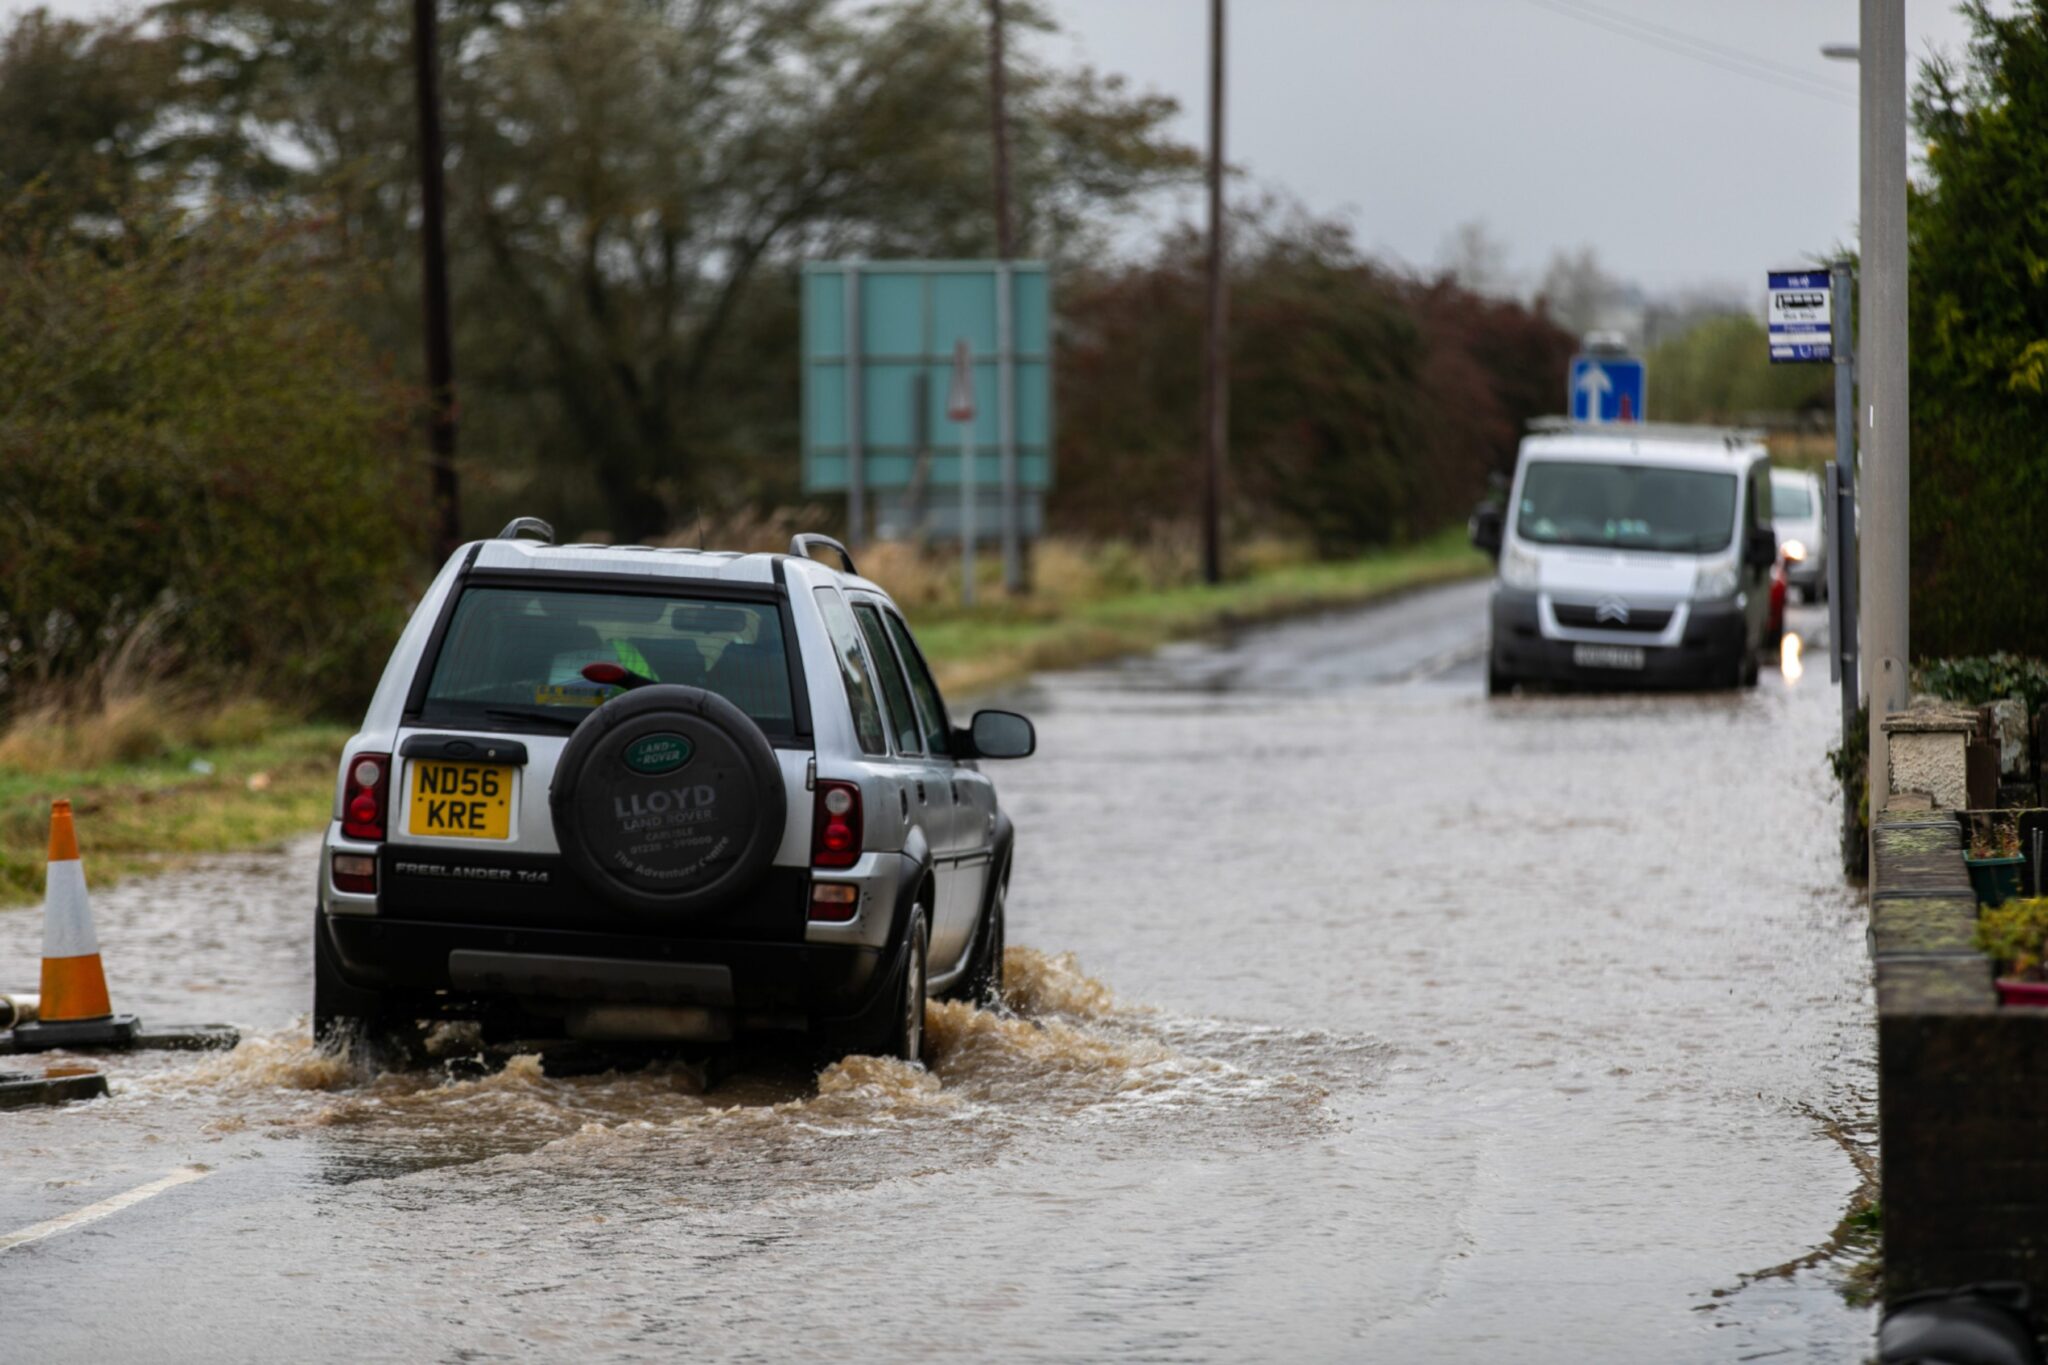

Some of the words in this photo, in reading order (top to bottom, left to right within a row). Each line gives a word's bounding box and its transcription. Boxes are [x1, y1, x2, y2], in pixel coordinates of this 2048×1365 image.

[419, 766, 499, 797] ND56
[427, 799, 488, 830] KRE
[614, 784, 716, 818] LLOYD
[623, 816, 662, 831] LAND
[666, 809, 712, 825] ROVER
[395, 862, 512, 880] FREELANDER
[517, 870, 549, 882] Td4
[614, 850, 634, 869] The
[635, 864, 697, 879] Adventure
